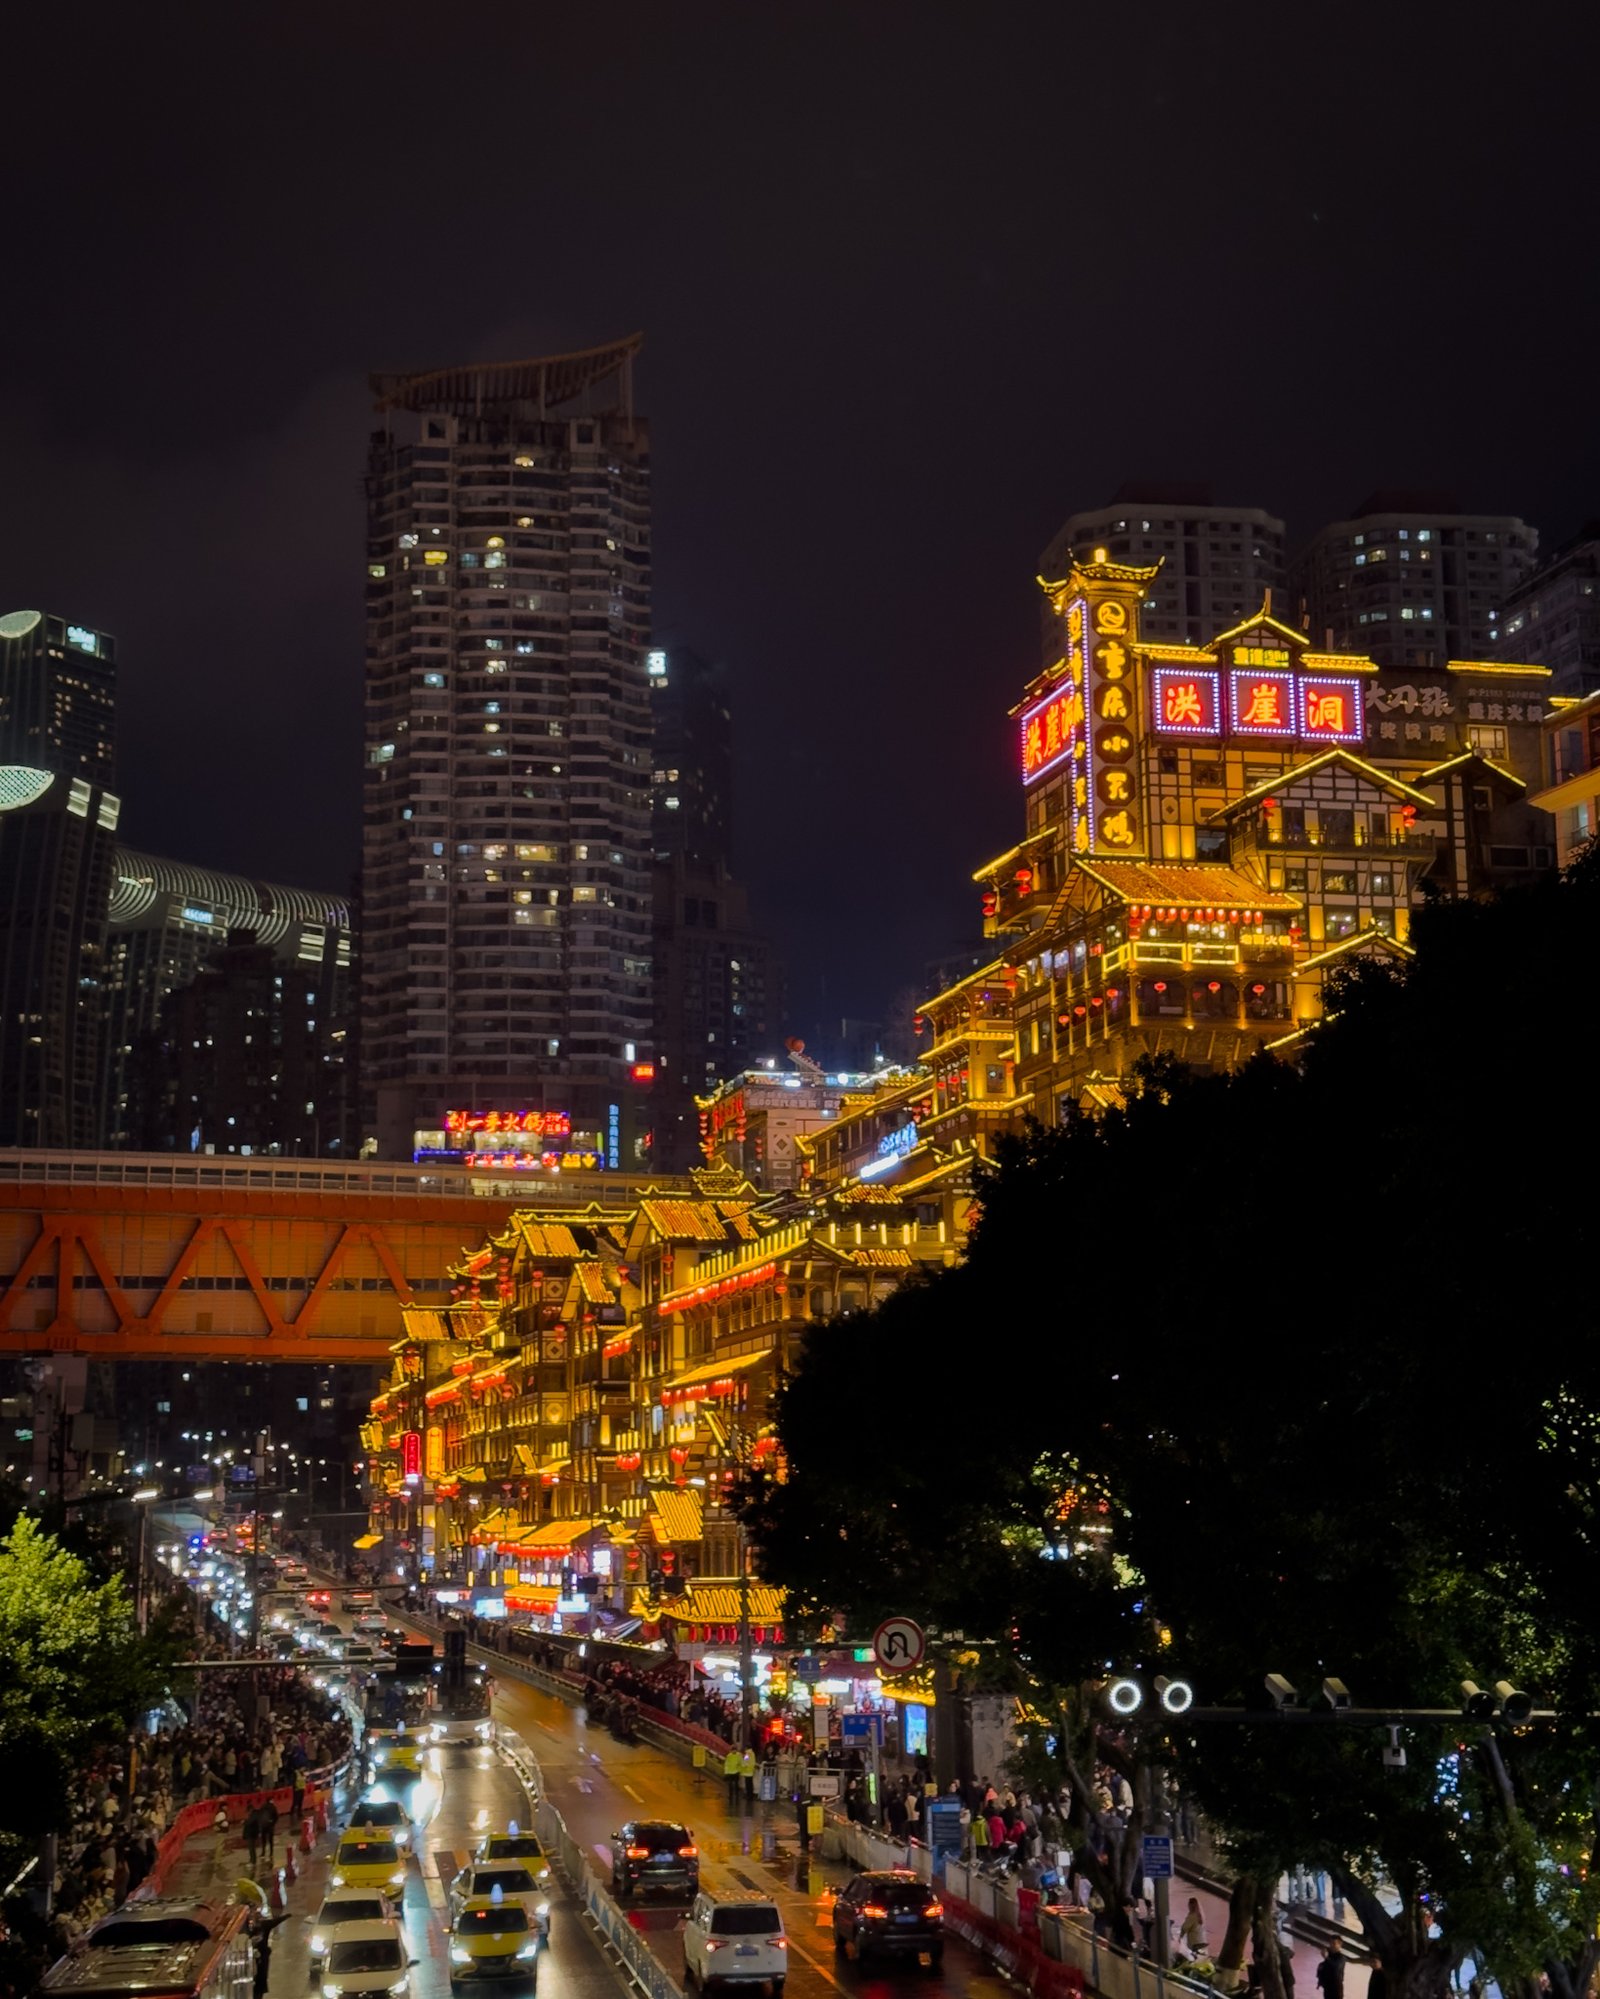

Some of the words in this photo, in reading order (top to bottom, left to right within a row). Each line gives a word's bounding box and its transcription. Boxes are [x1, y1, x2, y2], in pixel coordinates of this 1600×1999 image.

[1167, 684, 1343, 732] 洪崖洞
[1365, 679, 1455, 718] 大刀张
[1468, 702, 1543, 723] 重庆火锅
